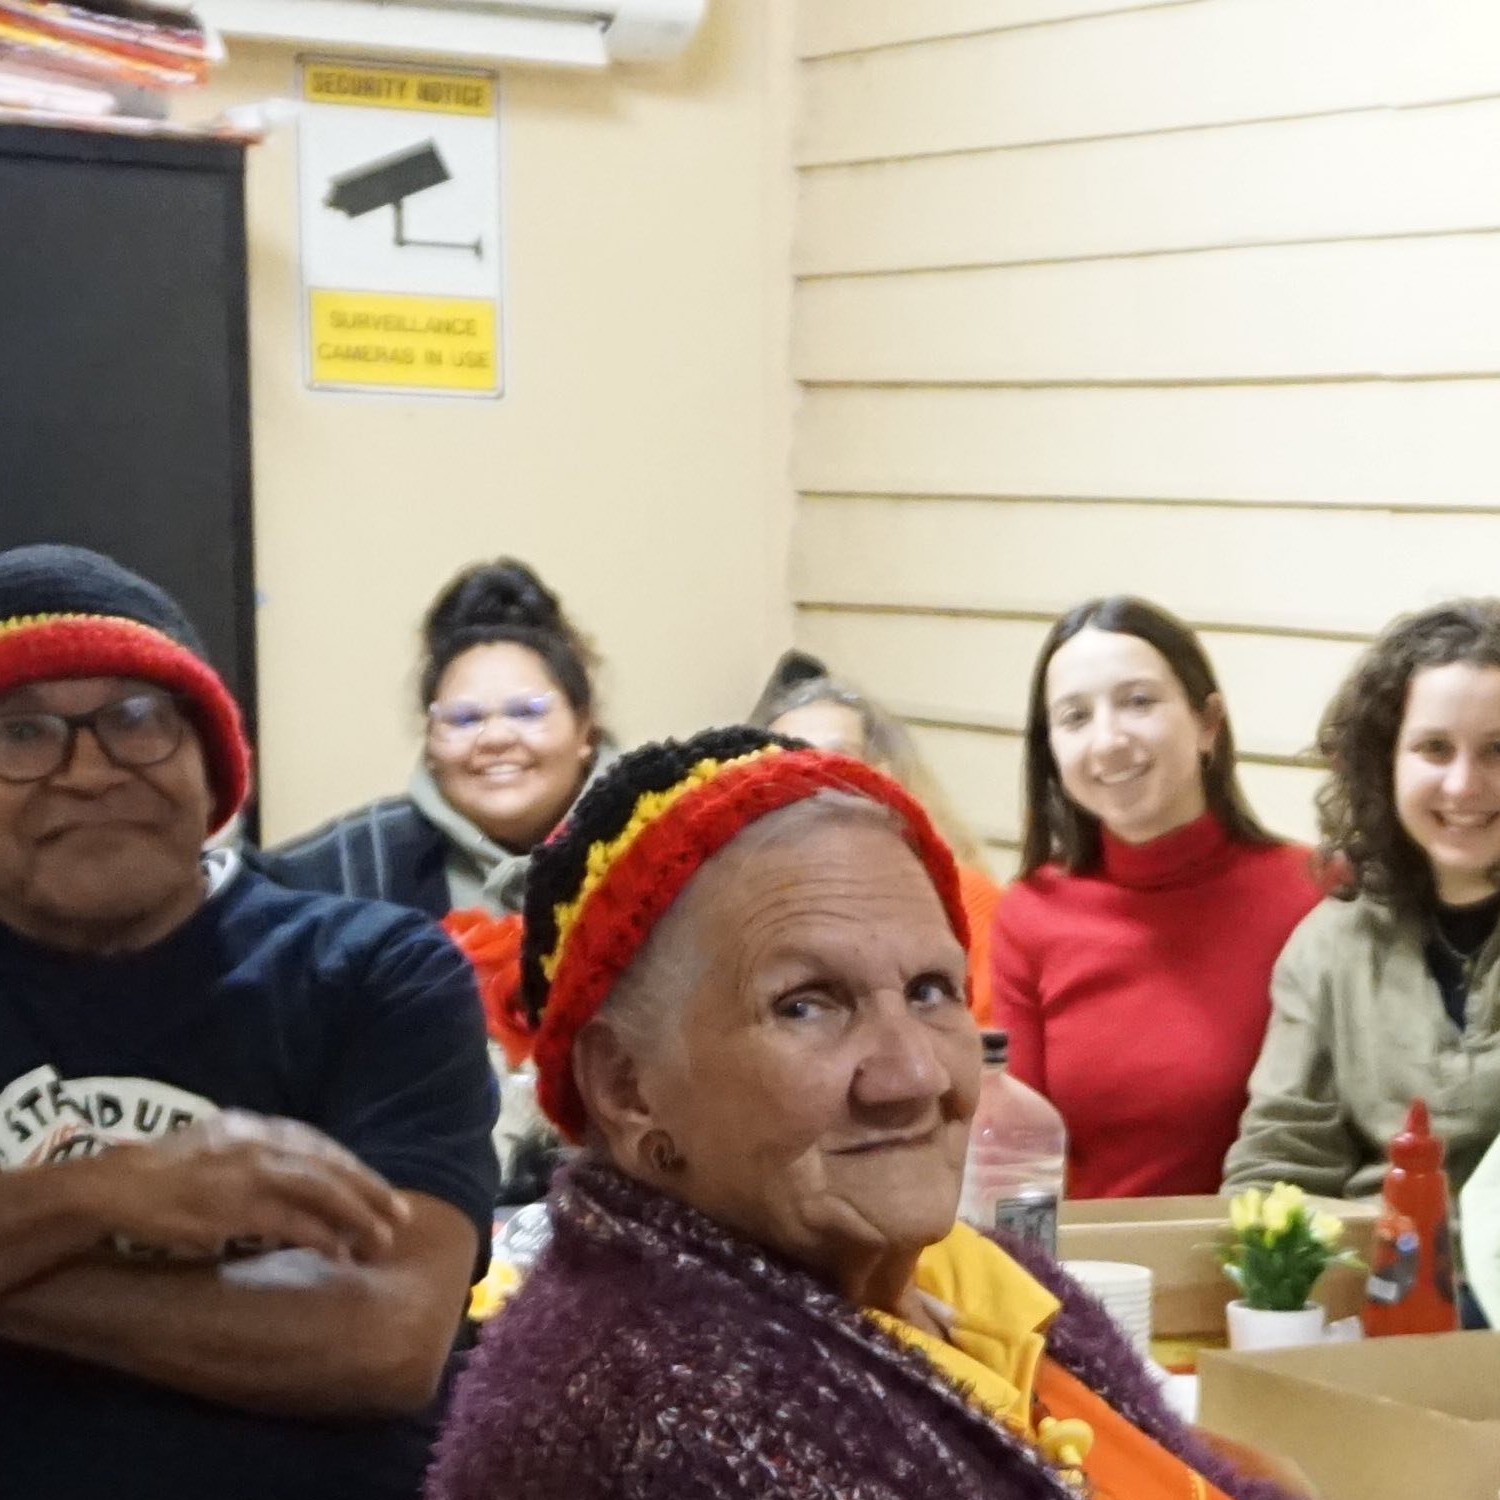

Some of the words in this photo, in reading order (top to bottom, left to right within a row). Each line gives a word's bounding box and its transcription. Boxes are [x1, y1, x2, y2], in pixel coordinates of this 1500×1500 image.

[311, 71, 408, 100] SECURITY
[417, 79, 484, 107] NOTICE
[328, 309, 477, 337] SURVEILLANCE
[317, 341, 415, 365] CAMERAS
[424, 349, 443, 367] IN
[452, 350, 491, 369] USE
